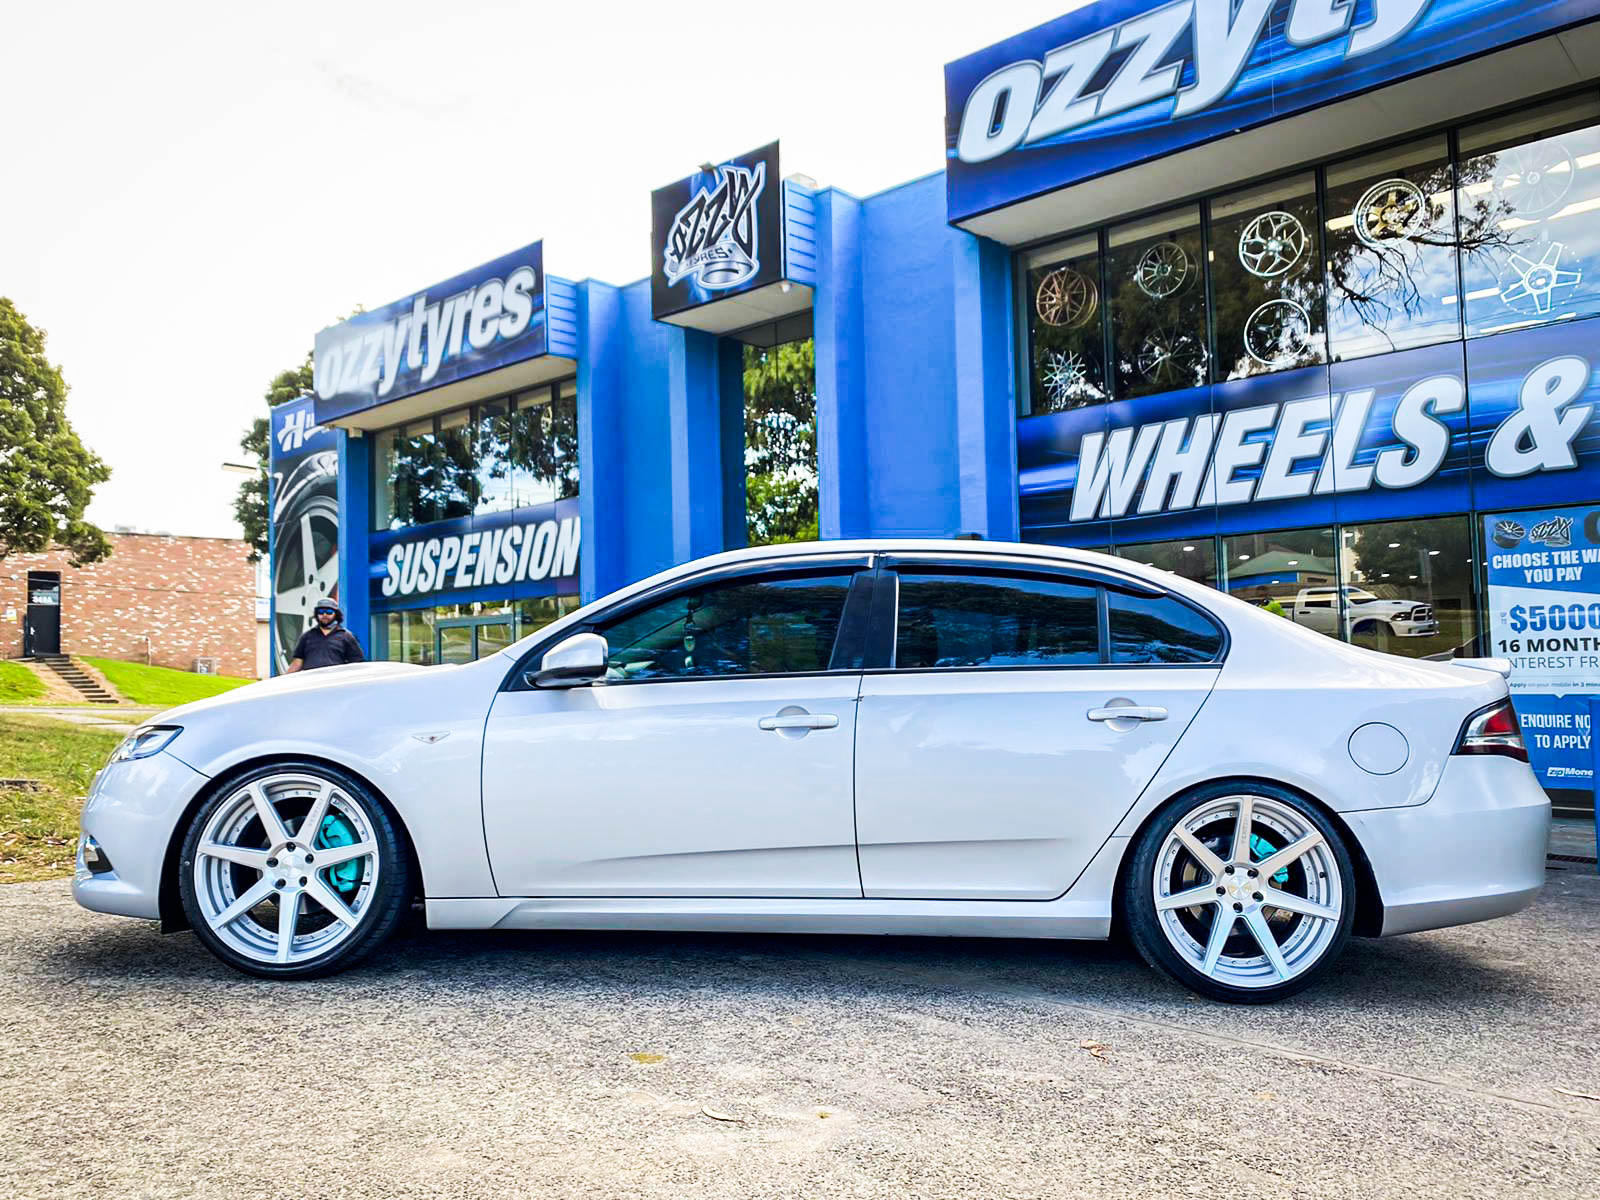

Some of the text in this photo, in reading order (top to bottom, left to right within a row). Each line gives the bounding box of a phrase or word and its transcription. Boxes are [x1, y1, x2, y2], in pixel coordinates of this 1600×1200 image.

[317, 265, 537, 401] ozzytyres
[1070, 355, 1595, 521] WHEELS &
[382, 516, 581, 597] SUSPENSION
[1492, 552, 1550, 569] CHOOSE
[1552, 550, 1580, 566] THE
[1524, 566, 1583, 584] YOU PAY
[1498, 639, 1521, 653] 16
[1520, 714, 1573, 729] ENQUIRE
[1534, 734, 1592, 750] TO APPLY
